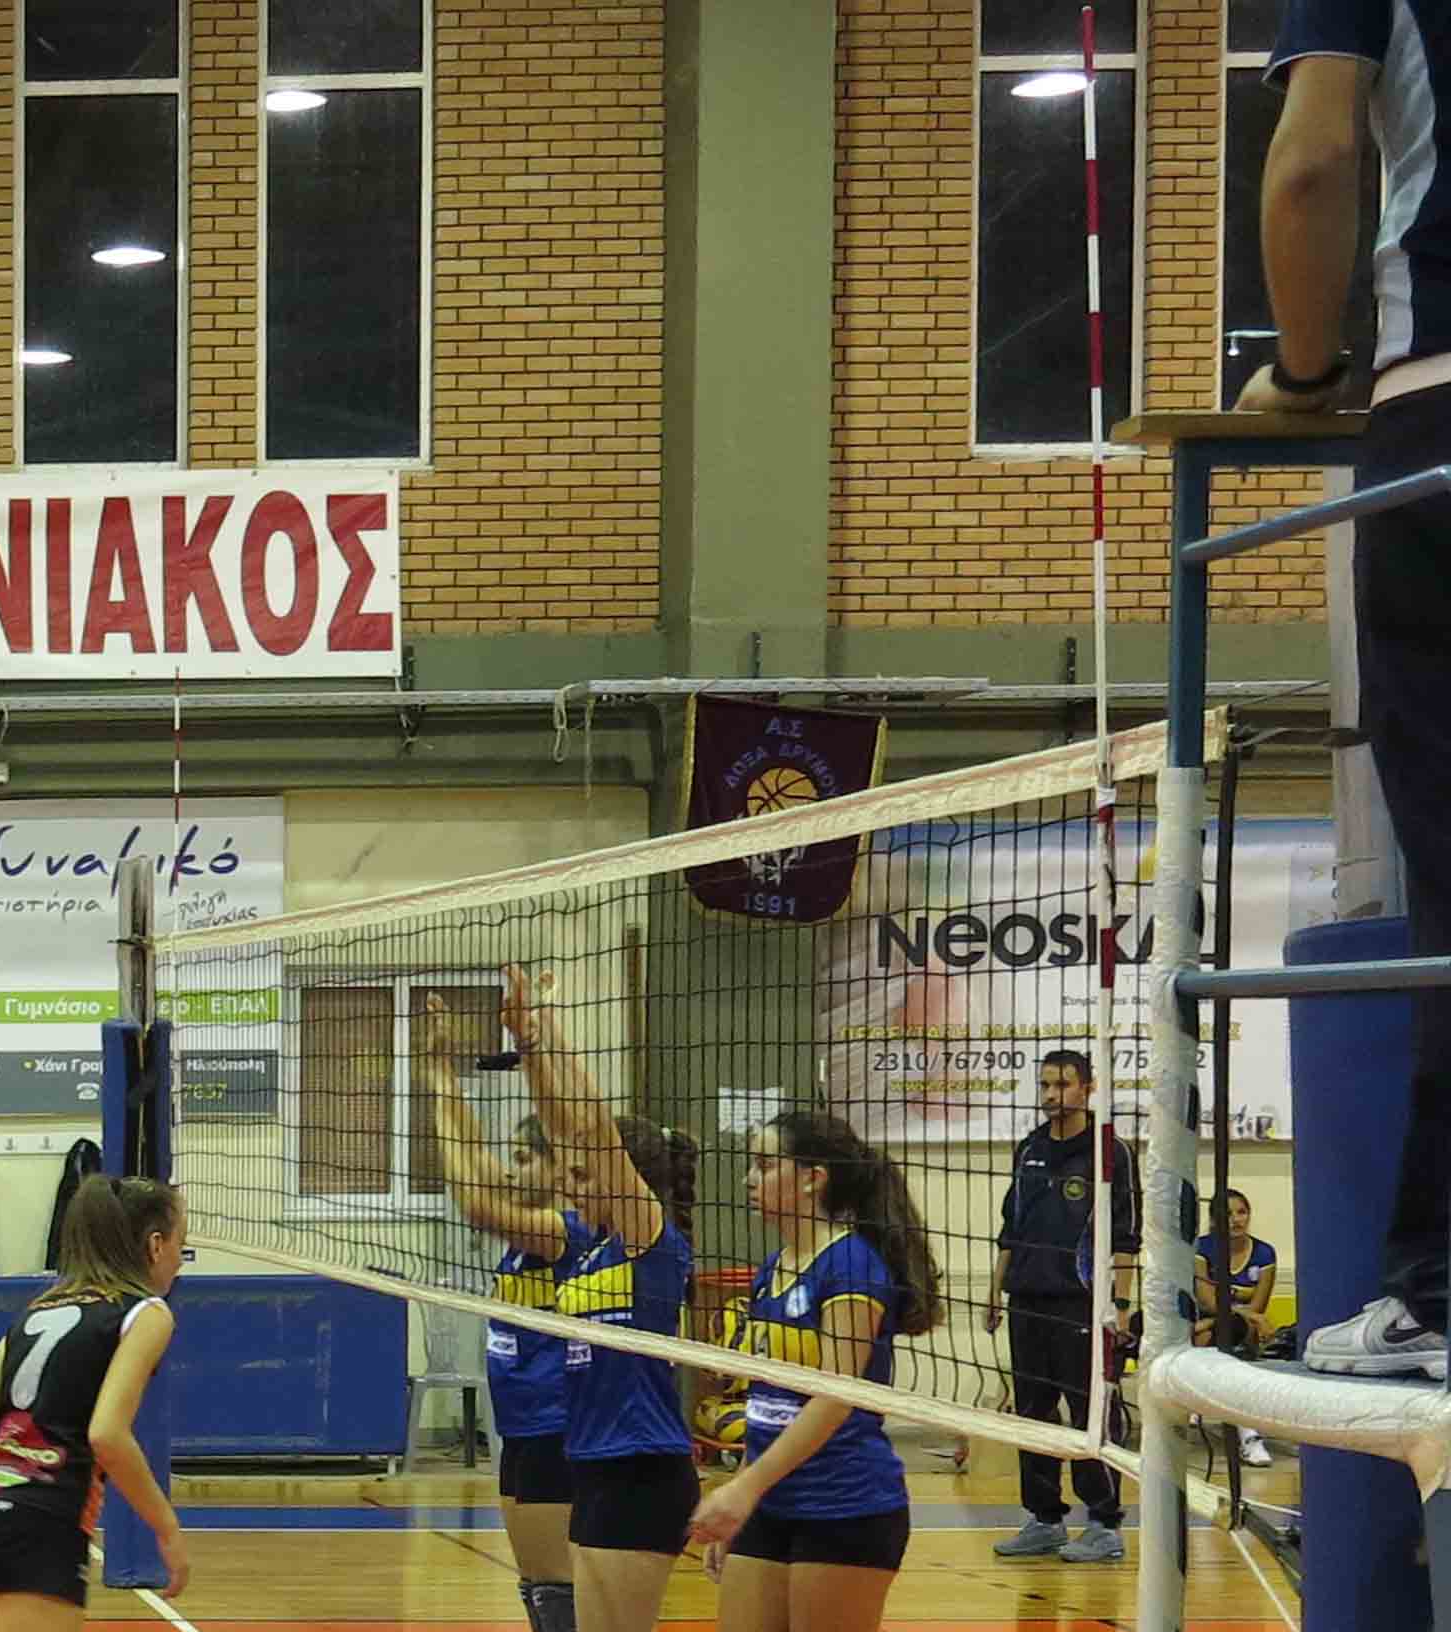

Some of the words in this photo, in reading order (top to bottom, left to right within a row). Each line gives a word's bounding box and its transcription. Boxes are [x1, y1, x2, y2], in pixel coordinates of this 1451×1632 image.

[4, 997, 101, 1019] Γυμνάσιο
[71, 1059, 103, 1075] Γρα
[10, 1305, 83, 1410] 7
